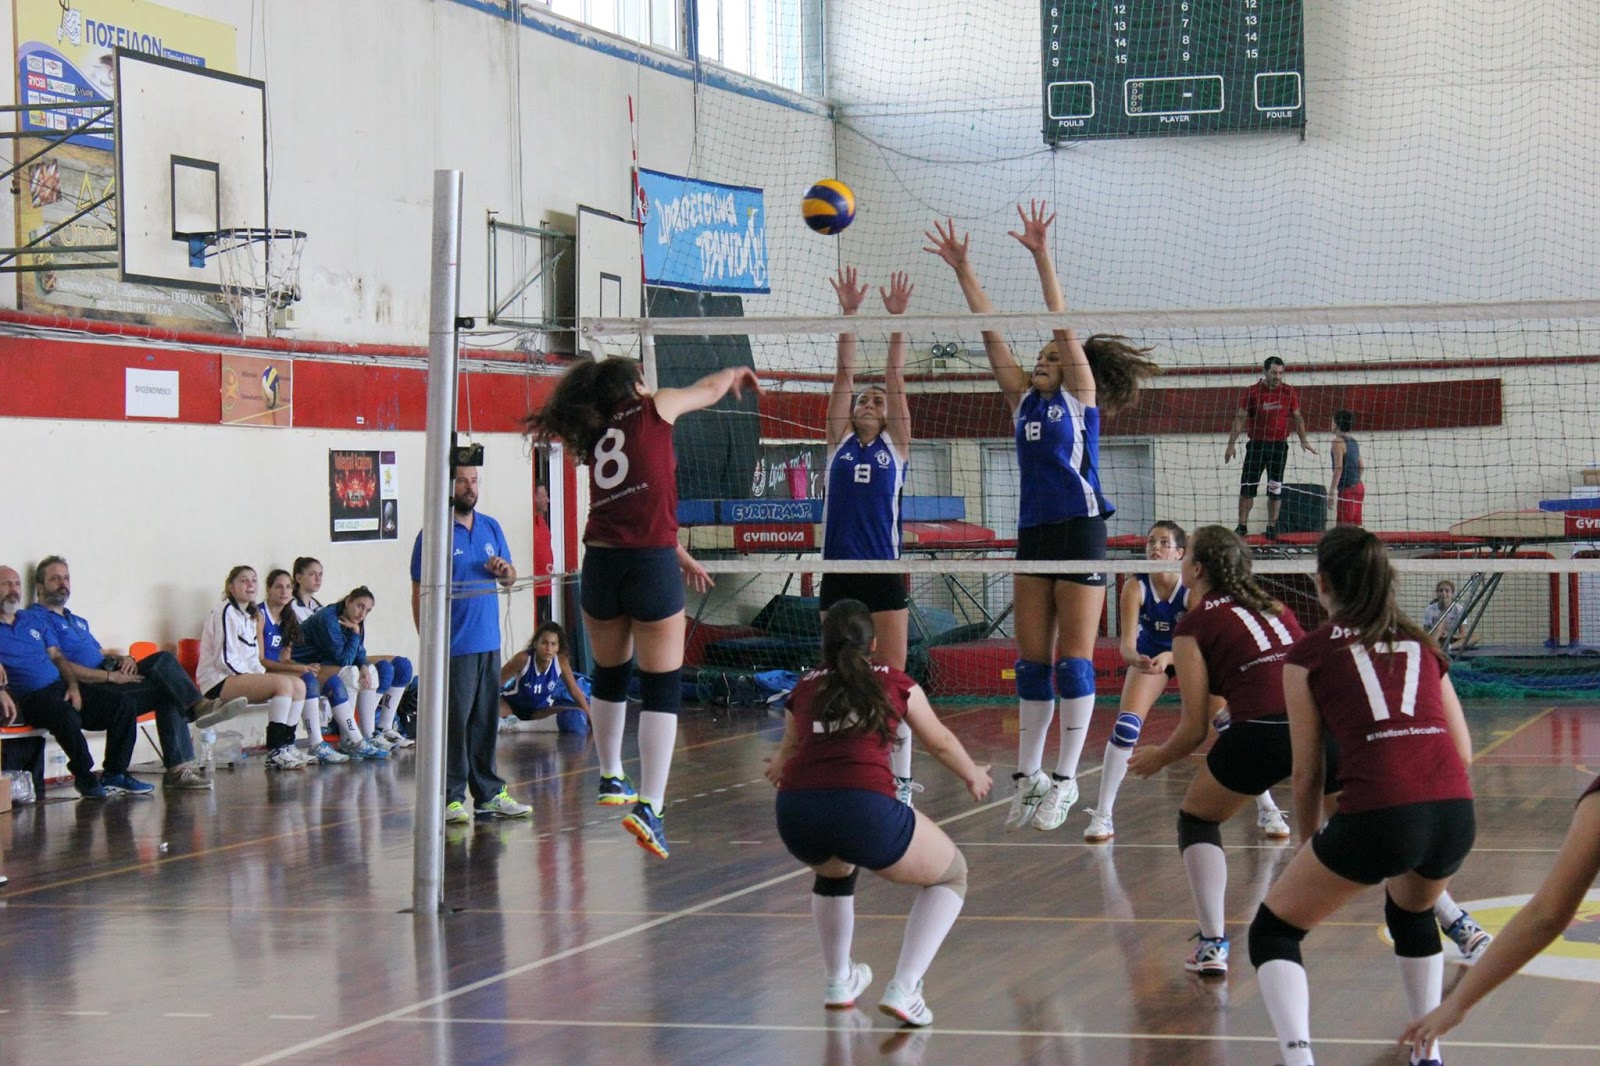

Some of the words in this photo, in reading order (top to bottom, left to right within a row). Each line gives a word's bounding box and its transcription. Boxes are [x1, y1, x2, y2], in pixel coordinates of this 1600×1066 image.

[1181, 2, 1188, 11] 6
[1245, 0, 1257, 8] 12
[1051, 8, 1058, 17] 6
[1114, 5, 1126, 14] 12
[1182, 19, 1189, 28] 7
[1245, 16, 1257, 25] 13
[1052, 25, 1059, 34] 7
[1114, 22, 1126, 31] 13
[1182, 35, 1189, 44] 8
[1245, 32, 1257, 42] 14
[1052, 42, 1059, 50] 8
[1115, 38, 1127, 47] 14
[1183, 52, 1190, 61] 9
[1246, 49, 1258, 58] 15
[1052, 58, 1059, 67] 9
[1115, 55, 1127, 64] 15
[1160, 115, 1190, 123] PLAYER
[1267, 111, 1292, 119] FOULS
[1025, 421, 1041, 441] 18
[594, 428, 630, 490] 8
[732, 503, 812, 521] EUROTRAMP
[1154, 621, 1170, 632] 15
[1231, 606, 1294, 652] 11
[1349, 641, 1421, 721] 17
